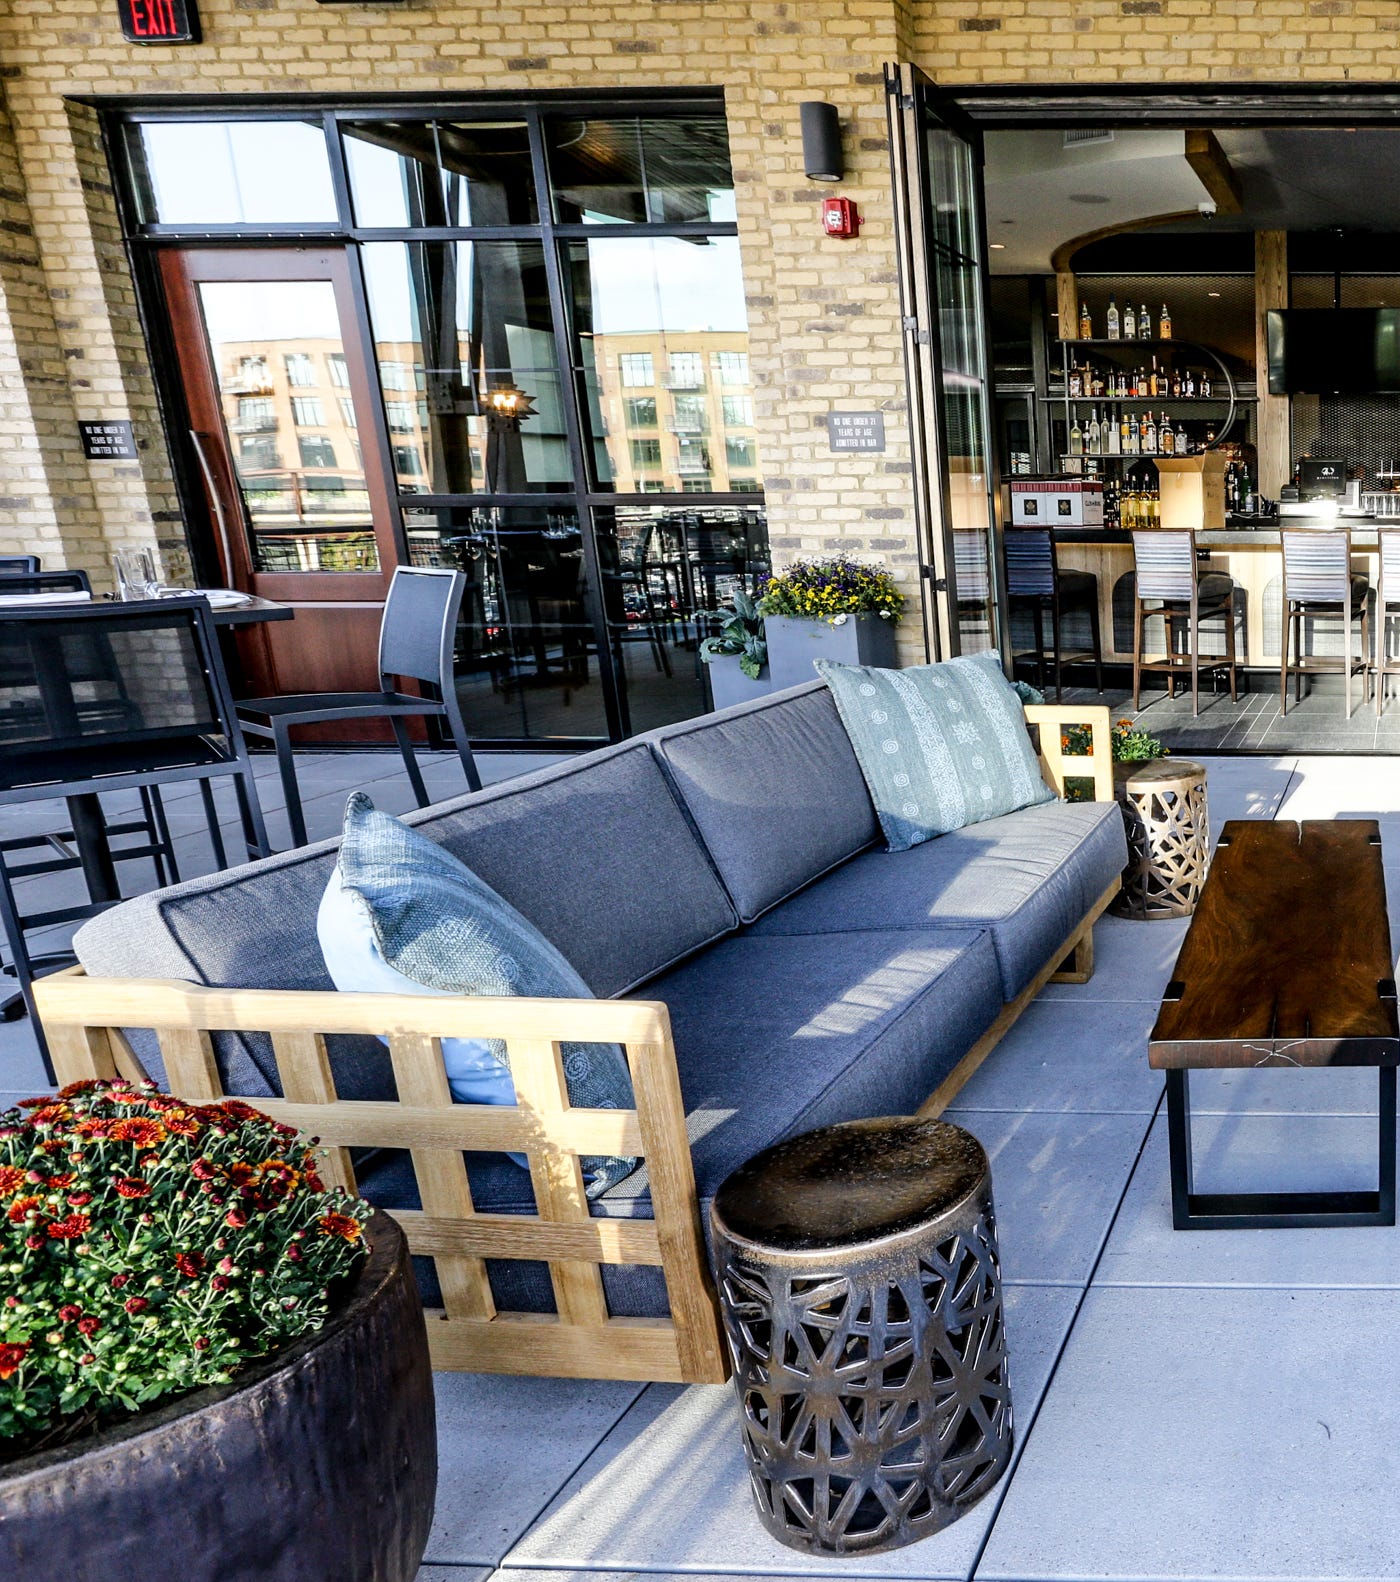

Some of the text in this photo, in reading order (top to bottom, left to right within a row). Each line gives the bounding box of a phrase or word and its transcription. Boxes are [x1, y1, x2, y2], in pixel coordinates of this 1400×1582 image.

[129, 0, 177, 35] EXIT
[833, 417, 840, 425] NO
[842, 417, 851, 425] ONE
[853, 417, 868, 425] UNDER
[838, 428, 873, 436] YEARS OF AGE
[836, 439, 877, 447] ADMITTED IN BAR
